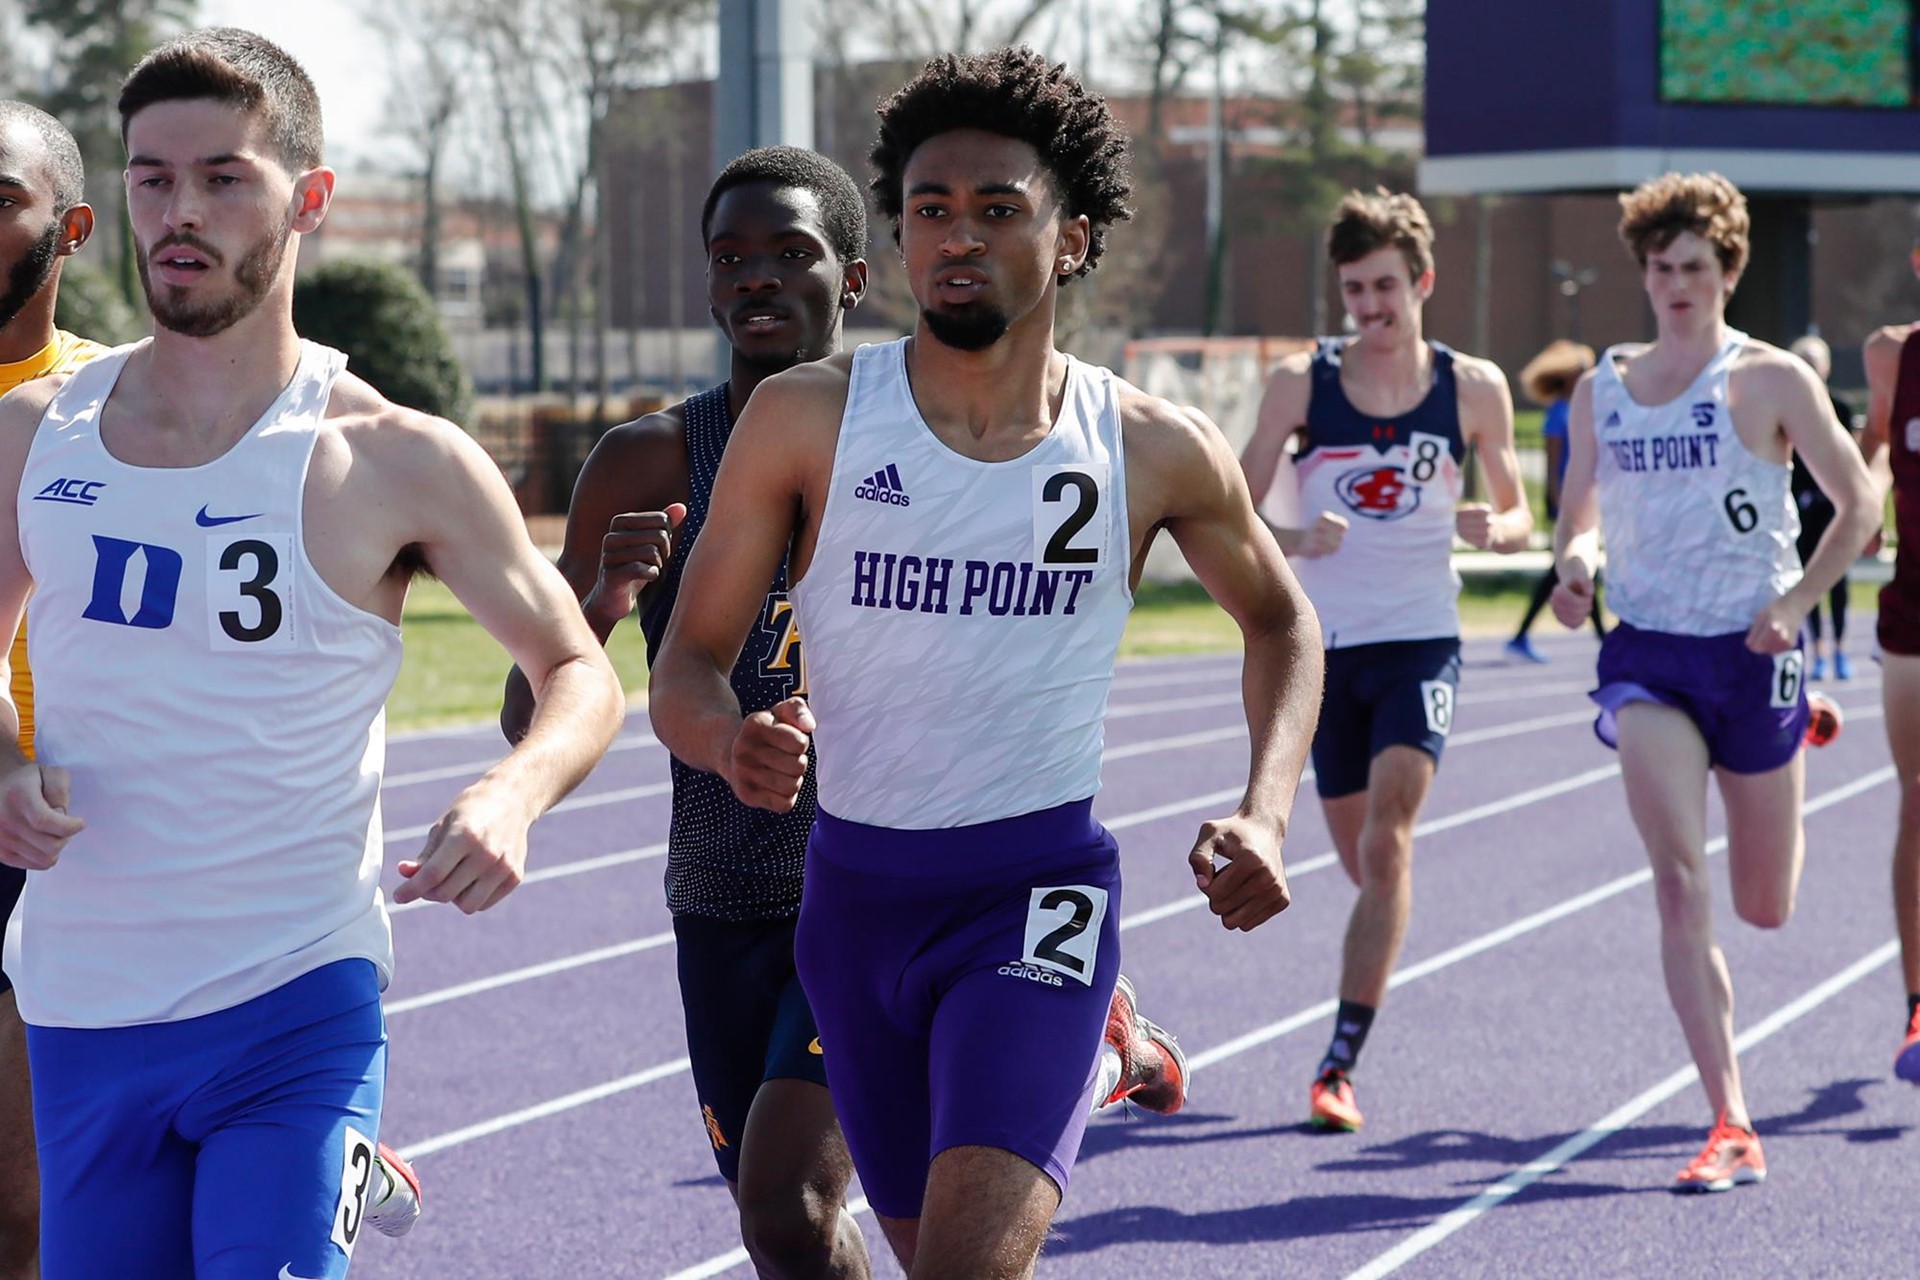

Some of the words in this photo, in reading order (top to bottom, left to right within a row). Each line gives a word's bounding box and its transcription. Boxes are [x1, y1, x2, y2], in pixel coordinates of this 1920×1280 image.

[1412, 440, 1440, 482] 8
[1652, 433, 1719, 470] POINT
[35, 477, 108, 503] ACC
[854, 484, 911, 507] adidas
[1723, 488, 1759, 535] 6
[1042, 471, 1099, 564] 2
[81, 534, 183, 630] D
[218, 539, 283, 643] 3
[851, 551, 954, 614] HIGH
[959, 560, 1093, 617] POINT
[1778, 657, 1797, 702] 6
[1431, 687, 1448, 729] 8
[1033, 889, 1094, 975] 2
[997, 965, 1063, 987] adidas
[343, 1142, 371, 1245] 3
